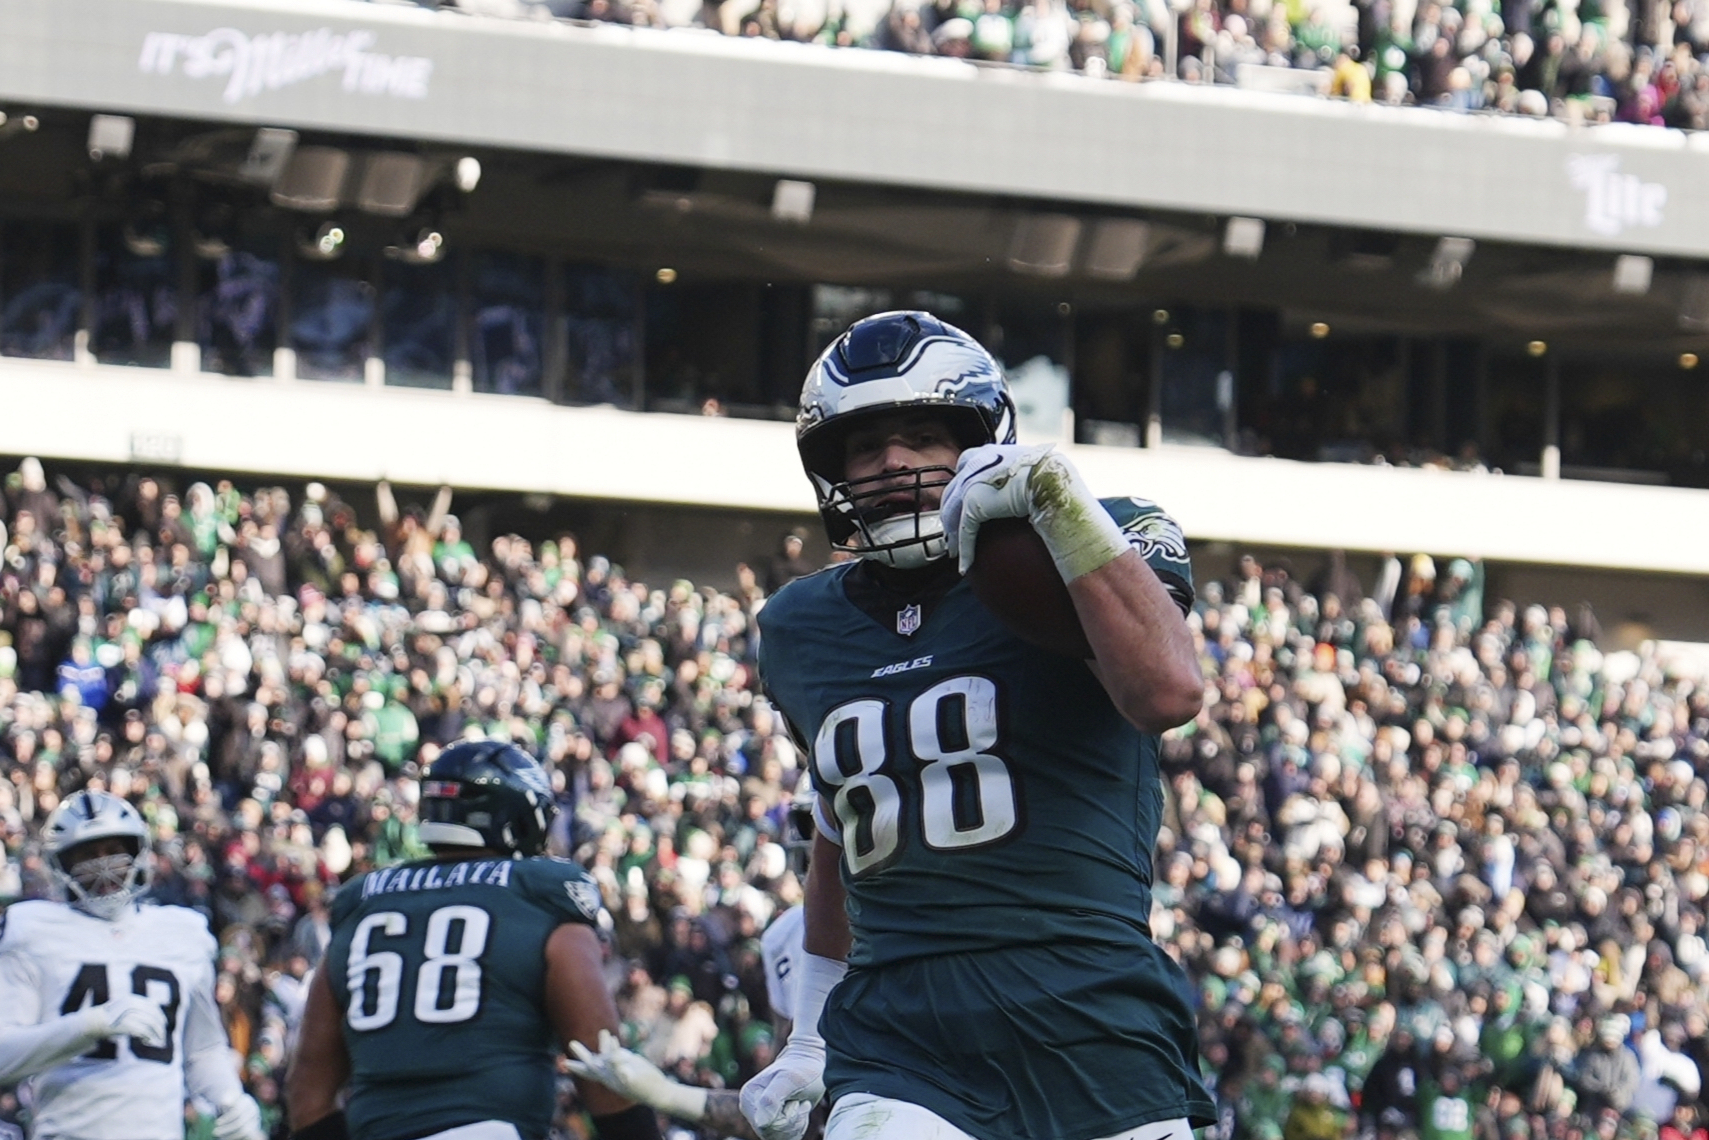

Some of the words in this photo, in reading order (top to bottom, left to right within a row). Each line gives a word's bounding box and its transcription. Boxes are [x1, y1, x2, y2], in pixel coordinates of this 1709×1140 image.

[870, 655, 934, 679] EAGLES
[813, 675, 1017, 876] 88
[361, 860, 513, 900] MAILATA
[348, 905, 490, 1031] 68
